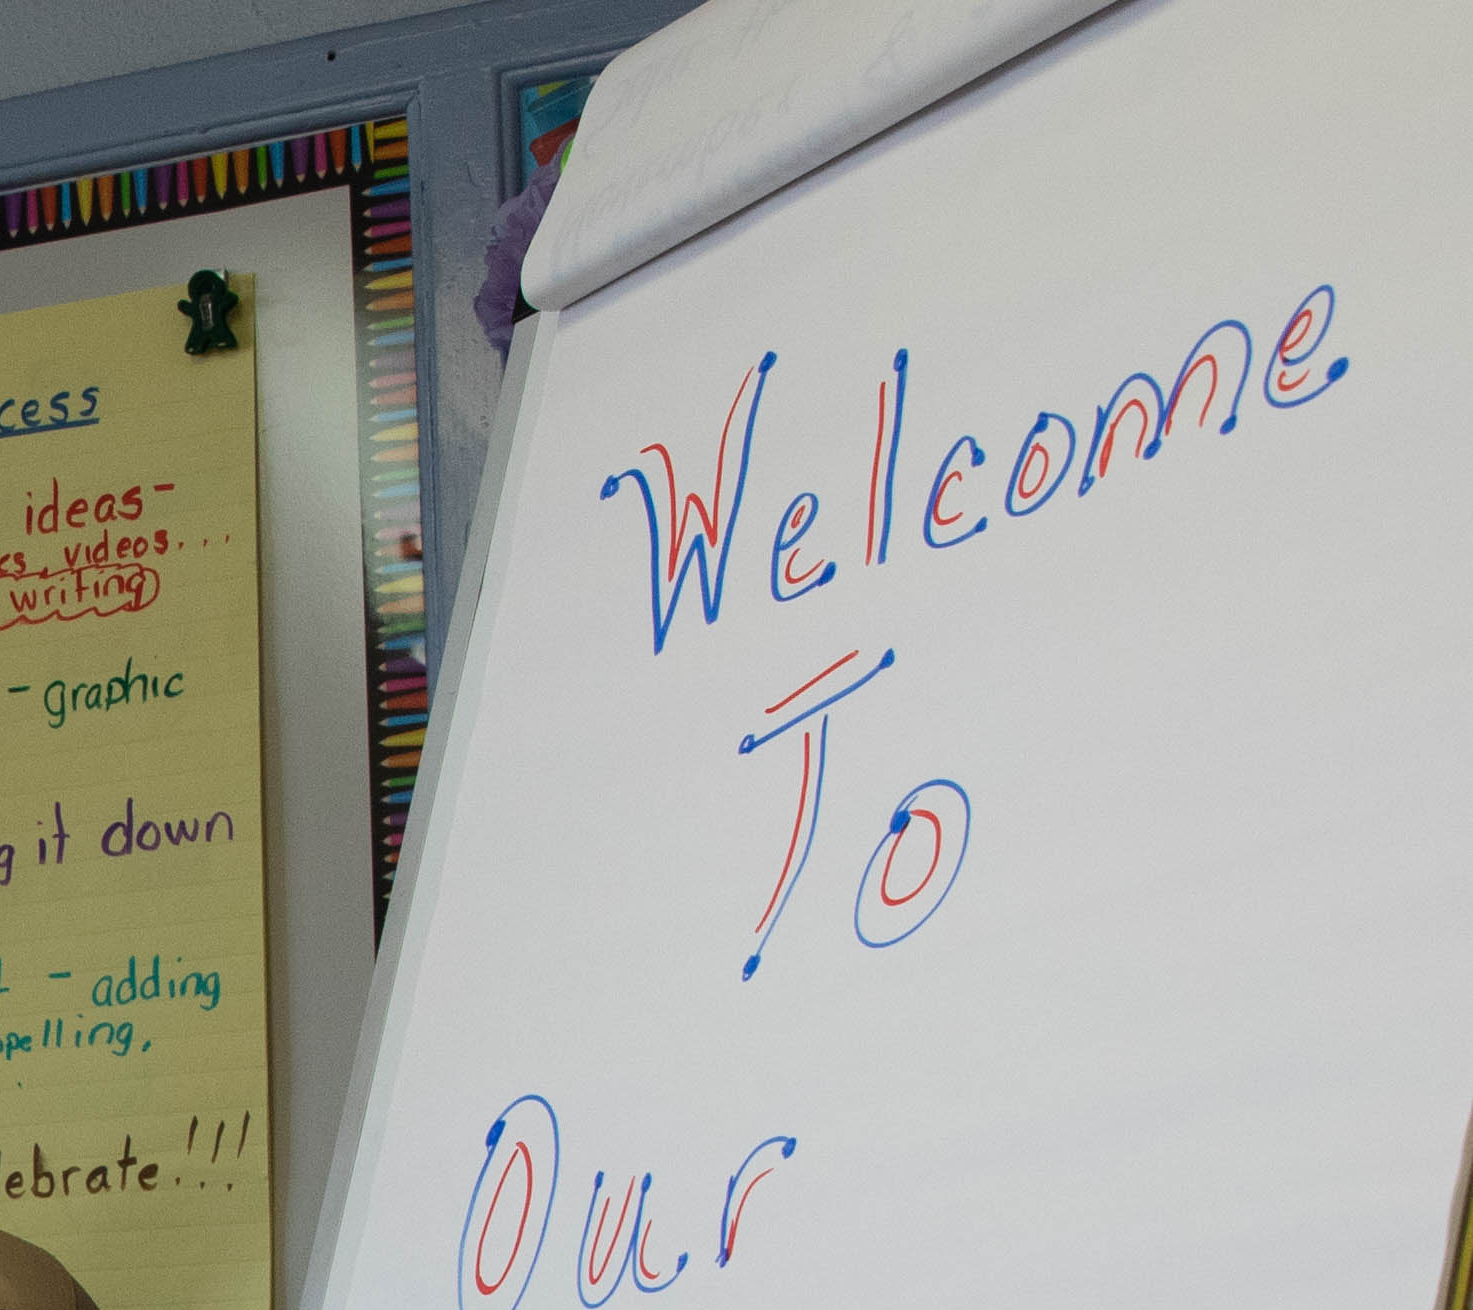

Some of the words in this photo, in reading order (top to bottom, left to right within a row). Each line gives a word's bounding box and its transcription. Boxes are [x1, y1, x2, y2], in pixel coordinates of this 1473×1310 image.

[601, 284, 1349, 653] Welcome
[43, 656, 185, 729] graphic
[38, 802, 71, 865] it
[101, 797, 235, 858] down
[740, 647, 971, 981] To
[91, 955, 222, 1012] adding
